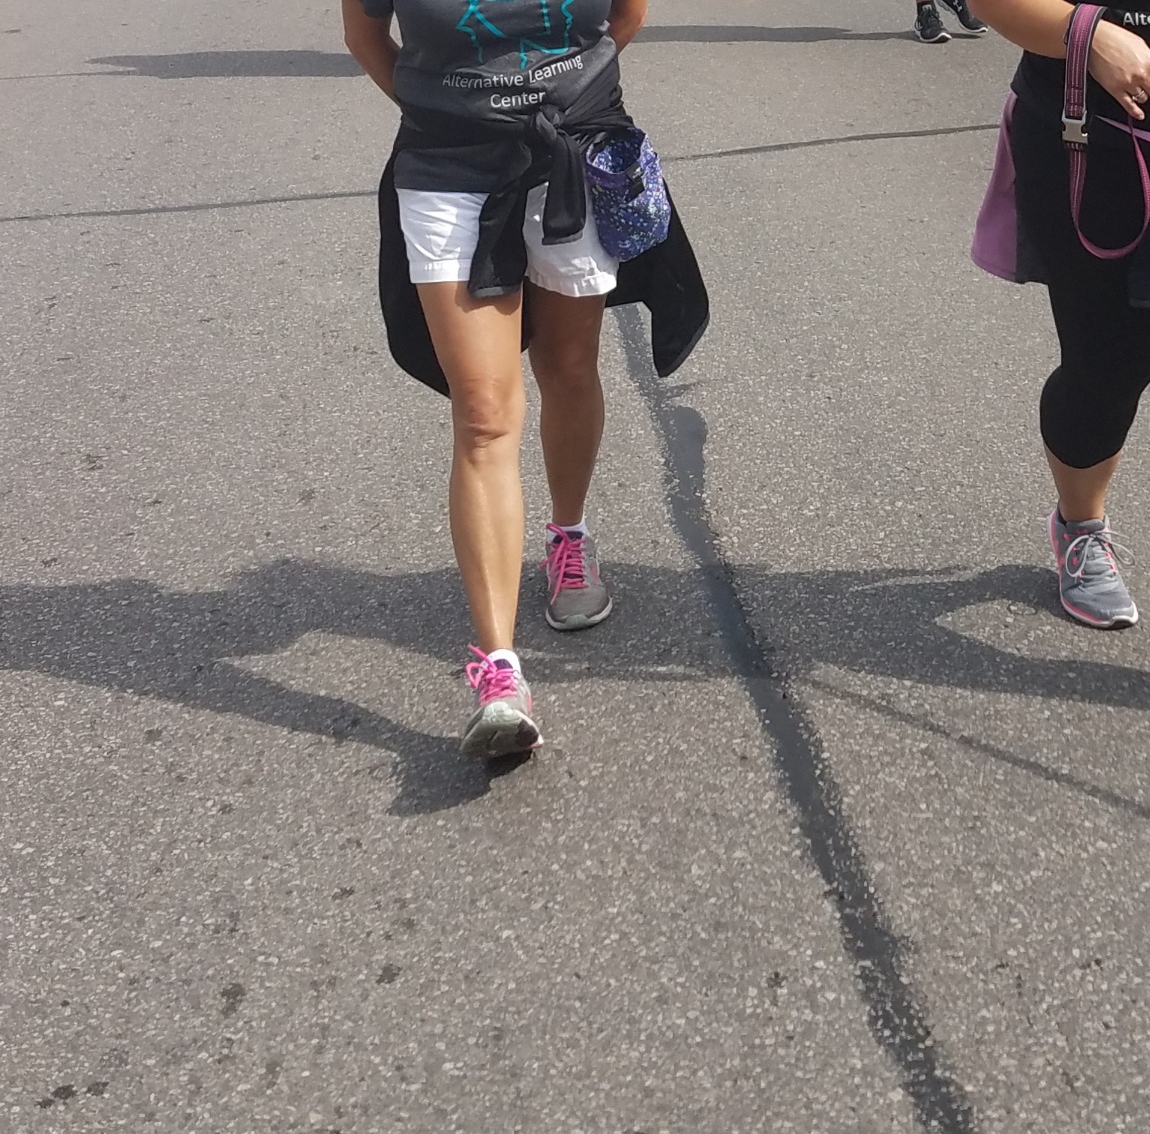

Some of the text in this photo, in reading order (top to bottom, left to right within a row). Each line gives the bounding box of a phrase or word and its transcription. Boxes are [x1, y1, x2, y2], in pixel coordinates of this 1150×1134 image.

[442, 54, 583, 89] Alternative Learning
[490, 90, 546, 108] Center
